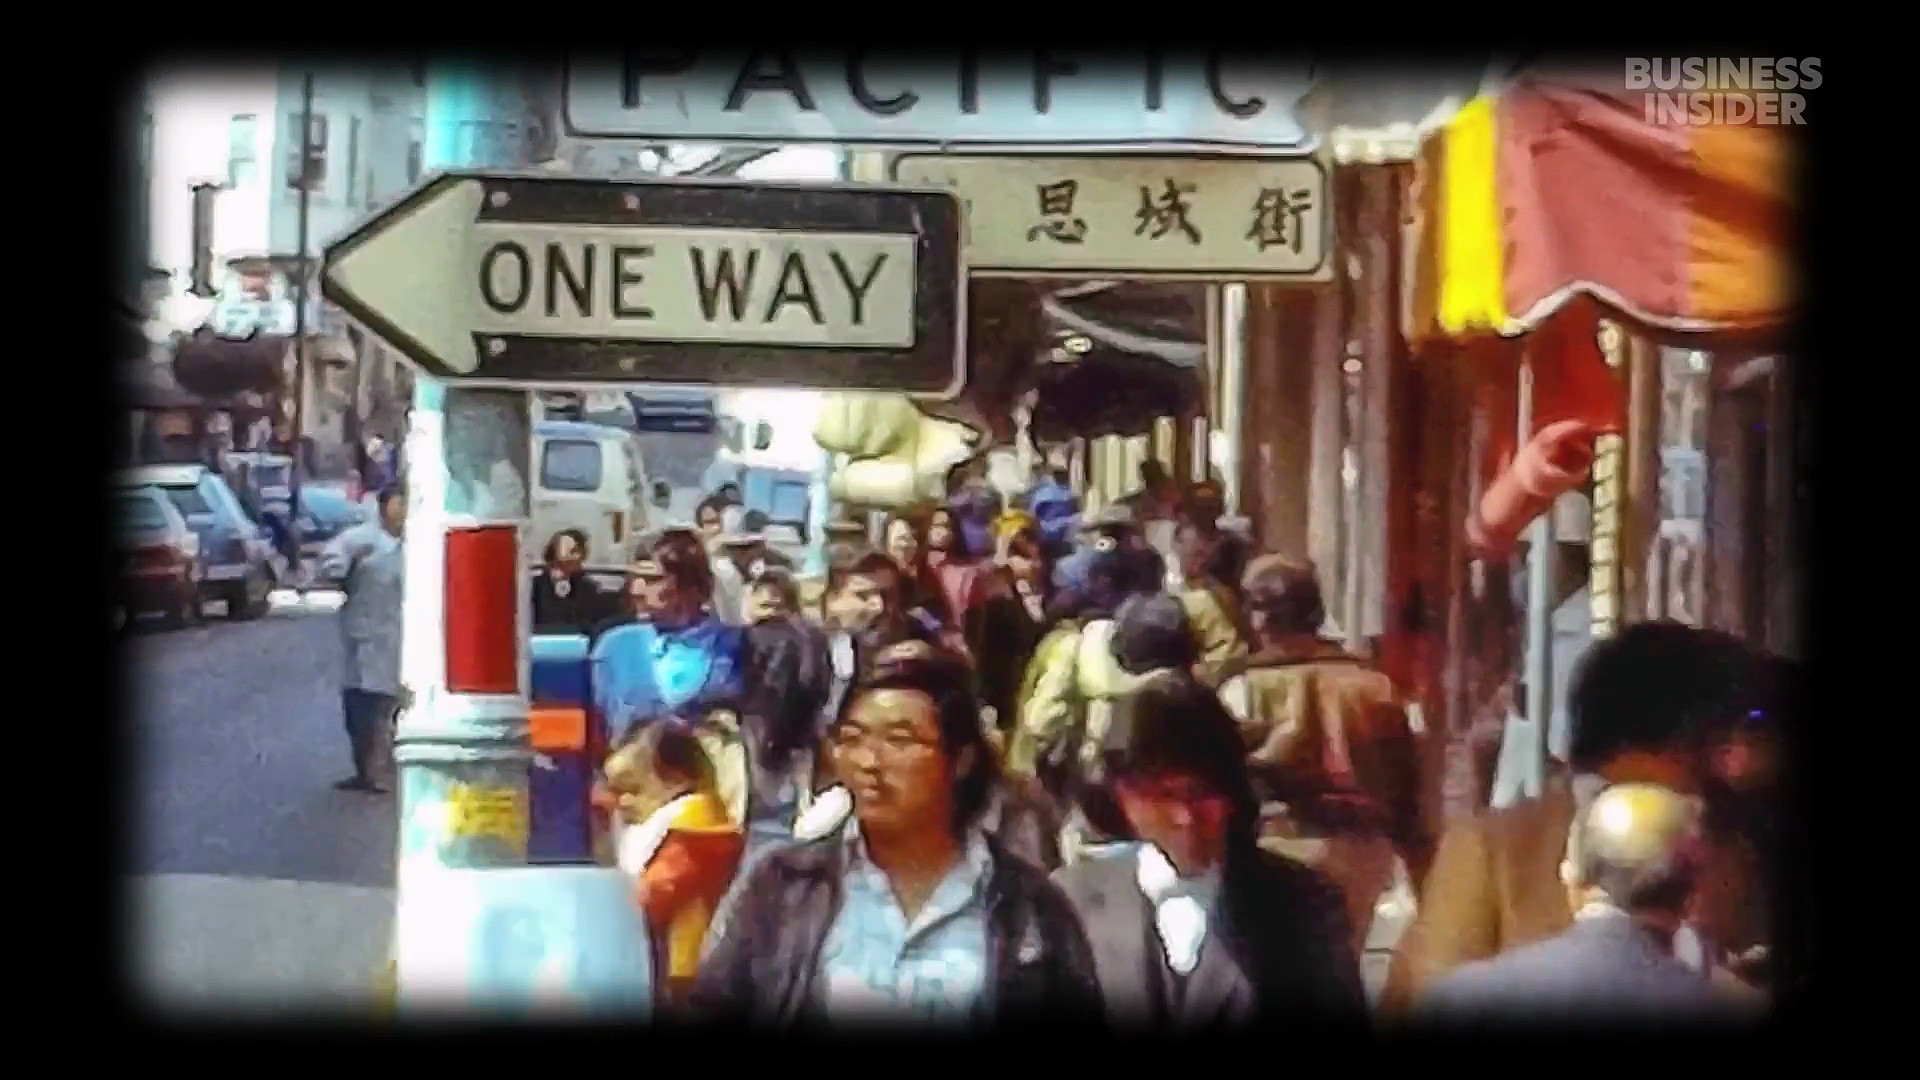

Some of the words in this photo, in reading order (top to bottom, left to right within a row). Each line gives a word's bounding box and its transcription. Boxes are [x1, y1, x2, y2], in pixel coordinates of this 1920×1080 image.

[621, 45, 1266, 118] PACIFIC
[955, 178, 1313, 255] 思域街
[479, 240, 656, 320] ONE
[689, 244, 890, 326] WAY
